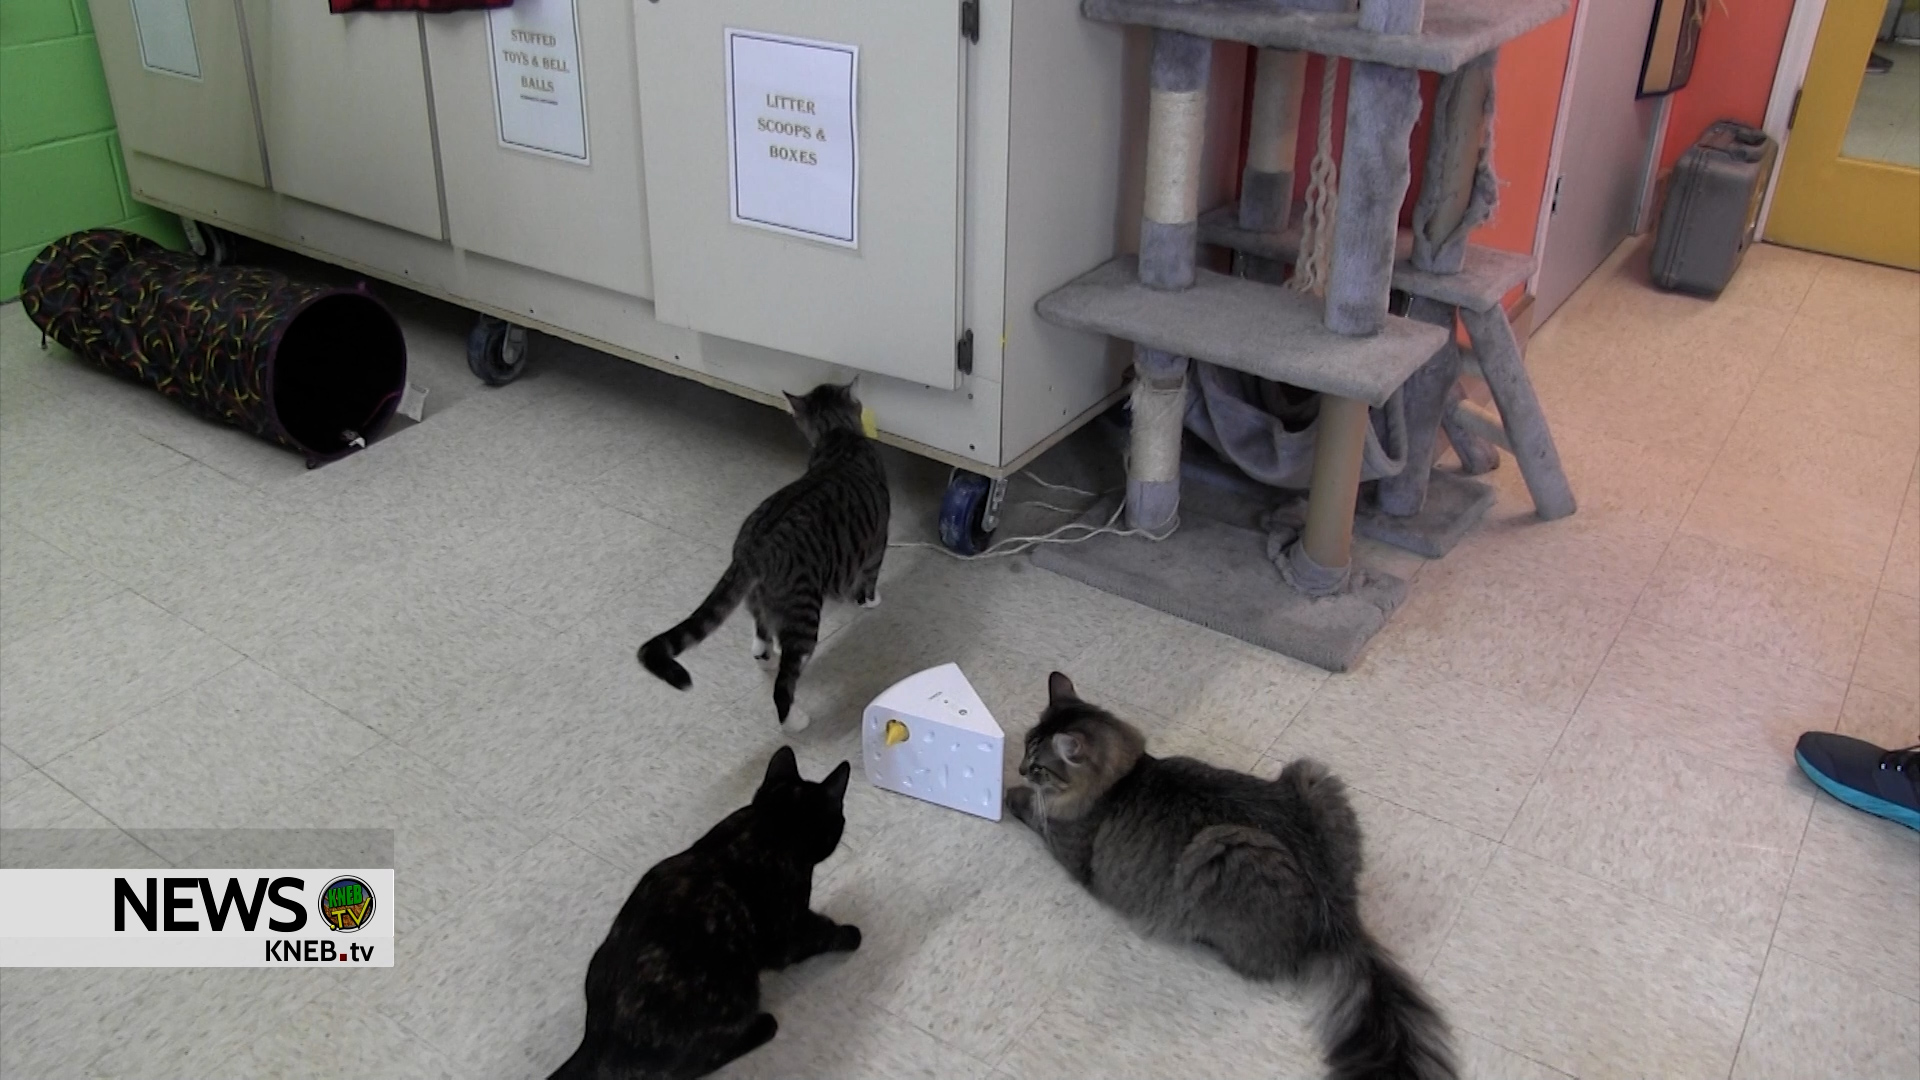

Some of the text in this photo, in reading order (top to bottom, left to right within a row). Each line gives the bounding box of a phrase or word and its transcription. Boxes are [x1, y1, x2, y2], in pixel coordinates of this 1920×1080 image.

[511, 29, 557, 48] STUFFED
[503, 50, 570, 73] TOYS & BELL
[521, 76, 555, 93] BALLS
[766, 93, 816, 115] LITTER
[757, 117, 827, 141] SCOOPS &
[769, 145, 818, 166] BOXES
